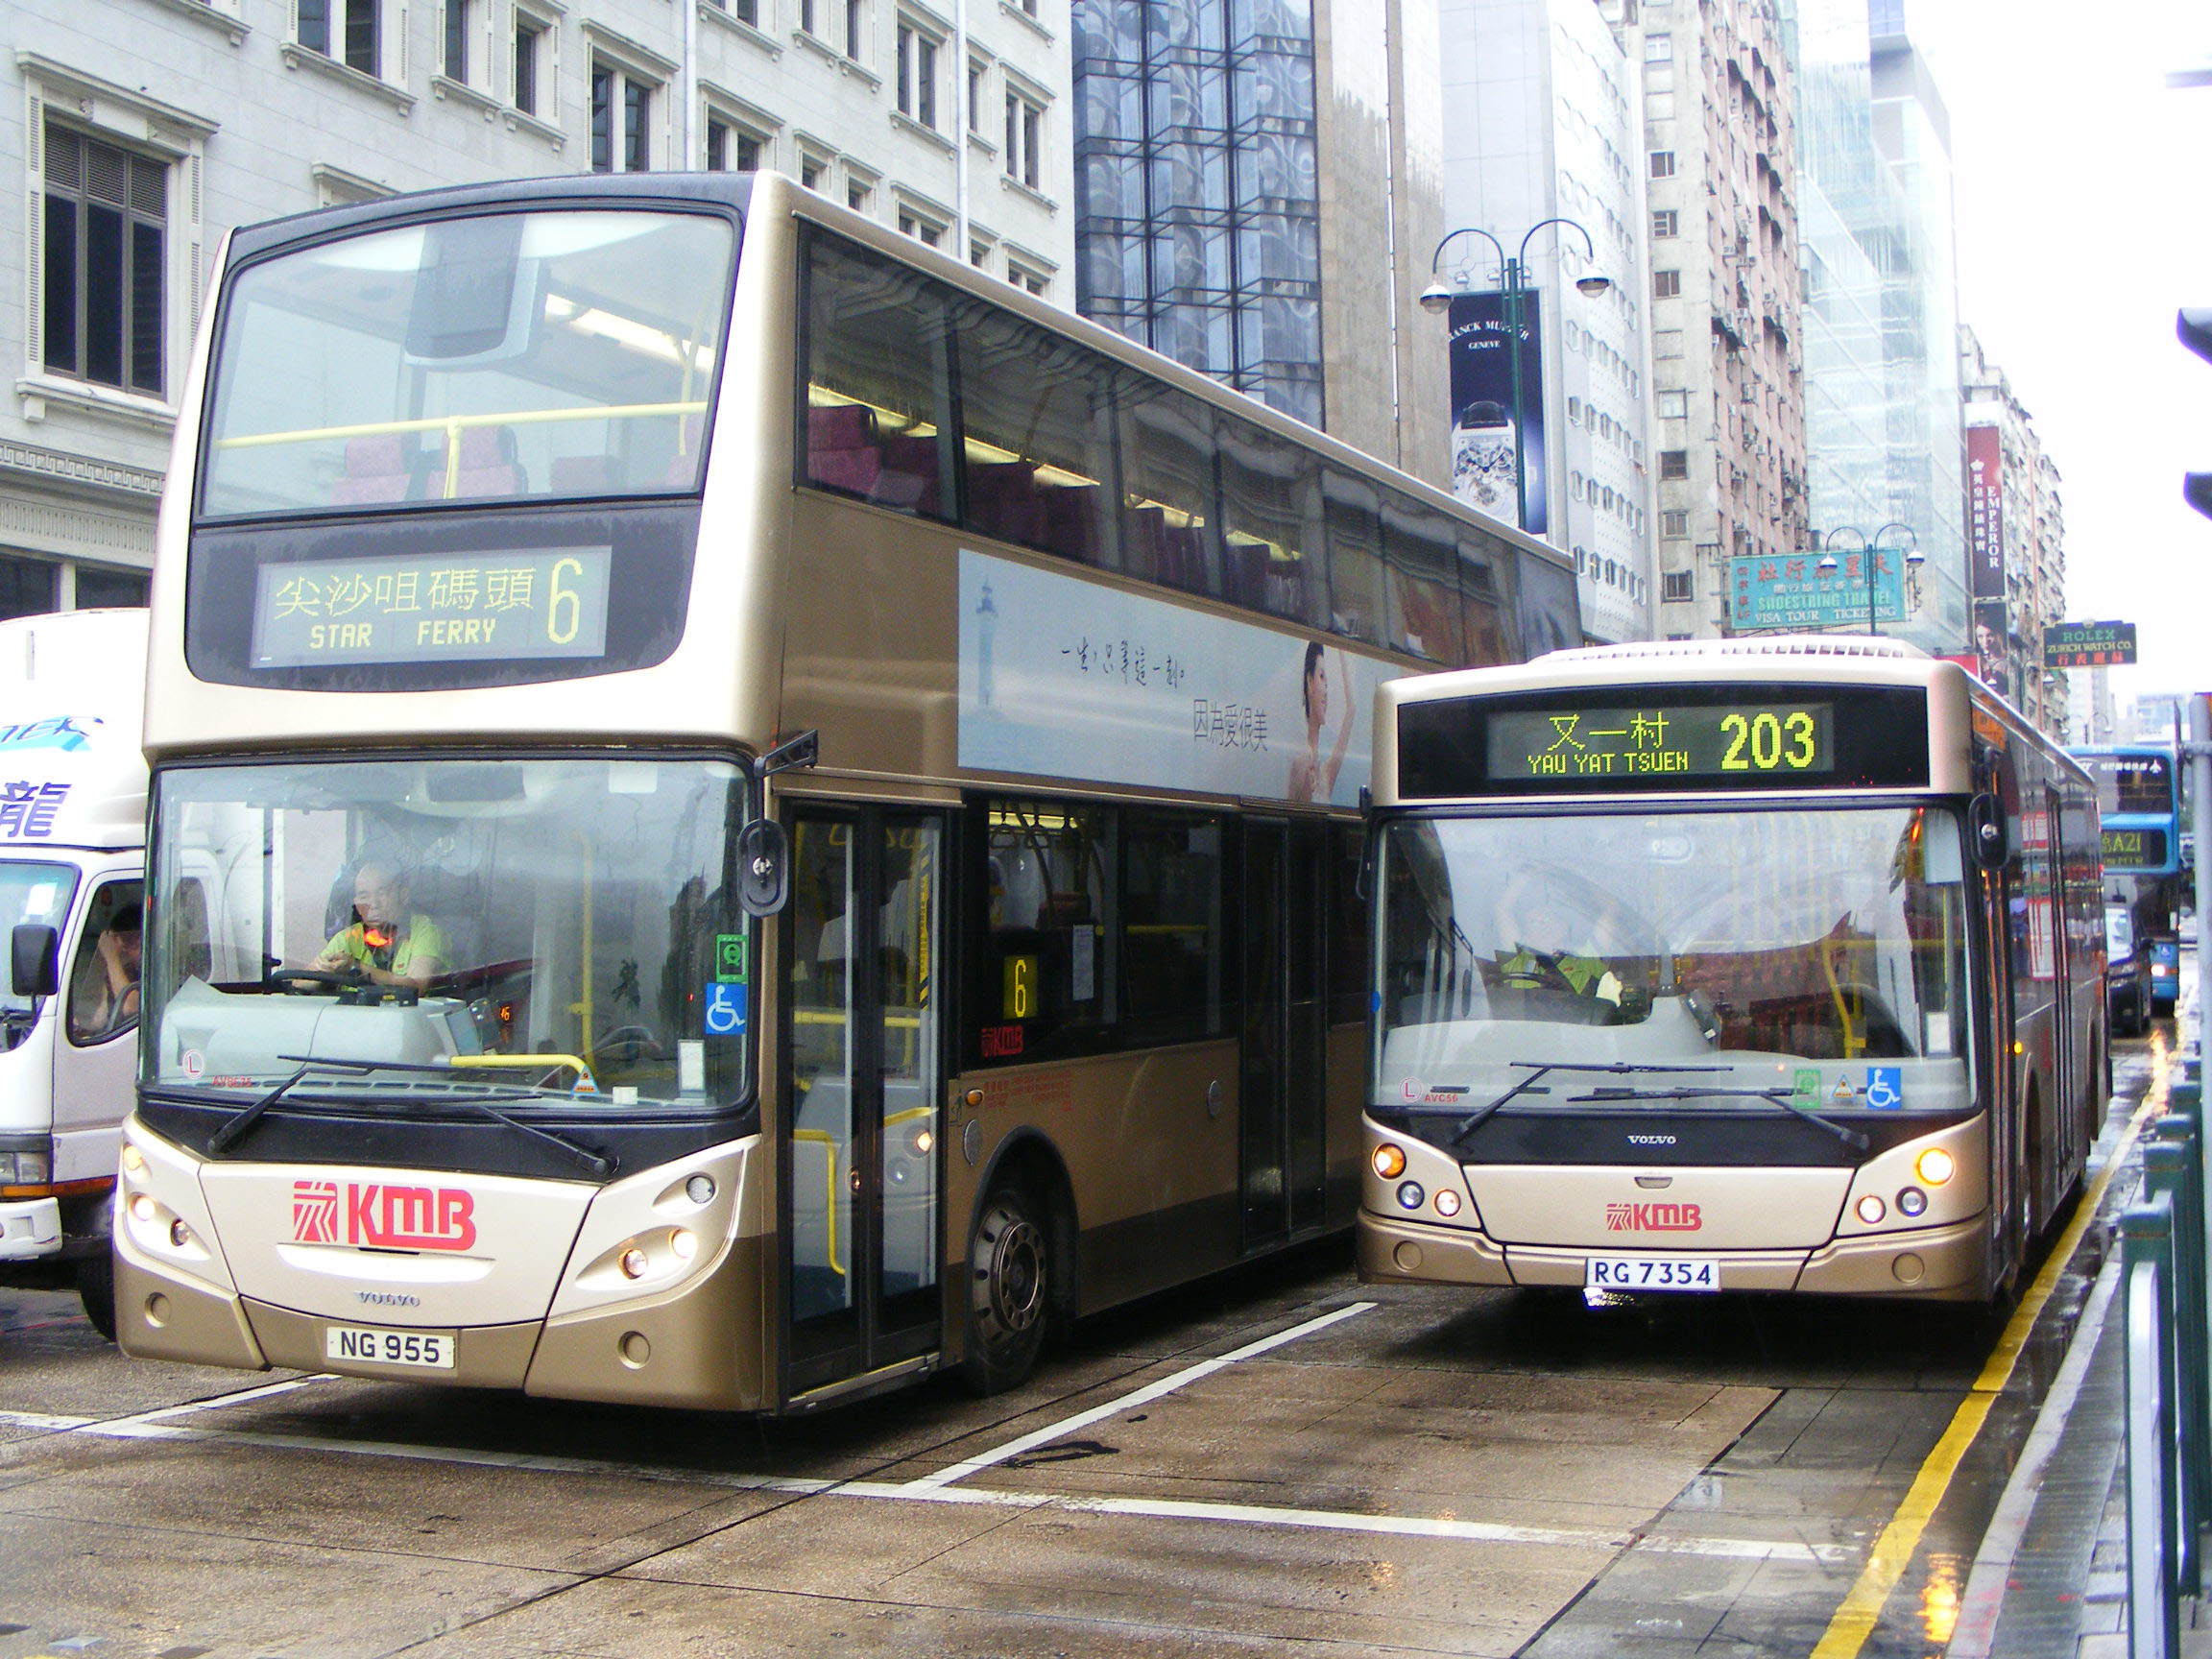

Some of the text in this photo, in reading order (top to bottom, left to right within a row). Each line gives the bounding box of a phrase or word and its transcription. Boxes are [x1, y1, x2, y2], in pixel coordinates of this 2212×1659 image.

[1468, 340, 1501, 349] GENEVE
[1986, 486, 2001, 568] EMPEROR
[275, 557, 584, 644] 尖沙咀碼頭 6
[1758, 593, 1840, 611] SHOESTRING
[1755, 611, 1781, 623] VISA
[1786, 610, 1819, 622] TOUR
[310, 617, 496, 649] STAR FERRY
[2062, 629, 2116, 642] ROLEX
[2048, 643, 2081, 654] ZURICH
[2083, 641, 2116, 652] WATCH
[1193, 699, 1268, 752] 因為愛很美
[1547, 711, 1815, 770] 又一村 203
[1527, 751, 1689, 774] YAU YAT TSUEN
[1014, 959, 1026, 1018] 6
[188, 1055, 200, 1073] L
[1405, 1082, 1415, 1097] L
[1424, 1094, 1458, 1102] AVC56
[1627, 1135, 1677, 1144] VOLVO
[348, 1183, 476, 1251] KMB
[1633, 1203, 1702, 1231] KMB
[1595, 1262, 1711, 1286] RG 7354
[353, 1290, 421, 1307] VOLVO
[341, 1331, 440, 1363] NG 955
